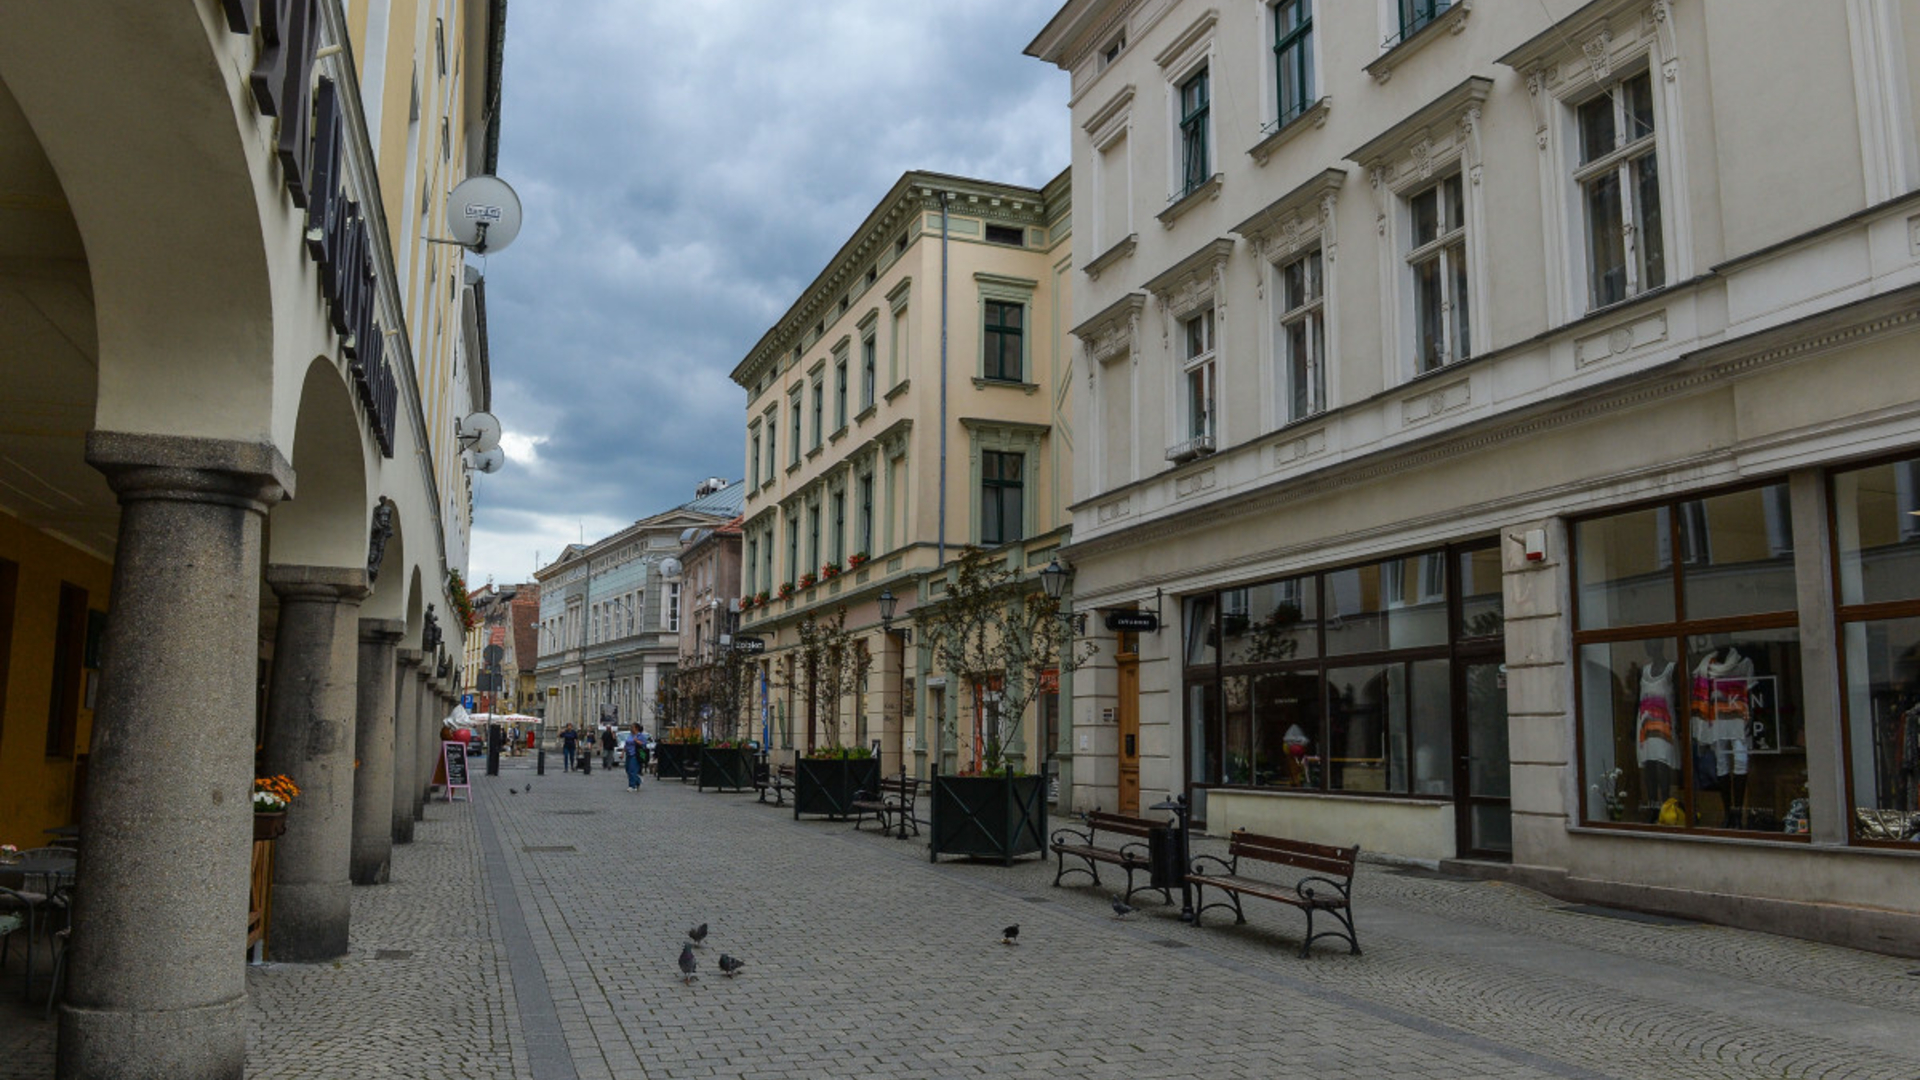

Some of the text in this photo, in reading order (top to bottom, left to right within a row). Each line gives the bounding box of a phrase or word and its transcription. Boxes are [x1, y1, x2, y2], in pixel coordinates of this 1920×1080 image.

[1727, 693, 1764, 709] K N
[1752, 721, 1764, 737] P
